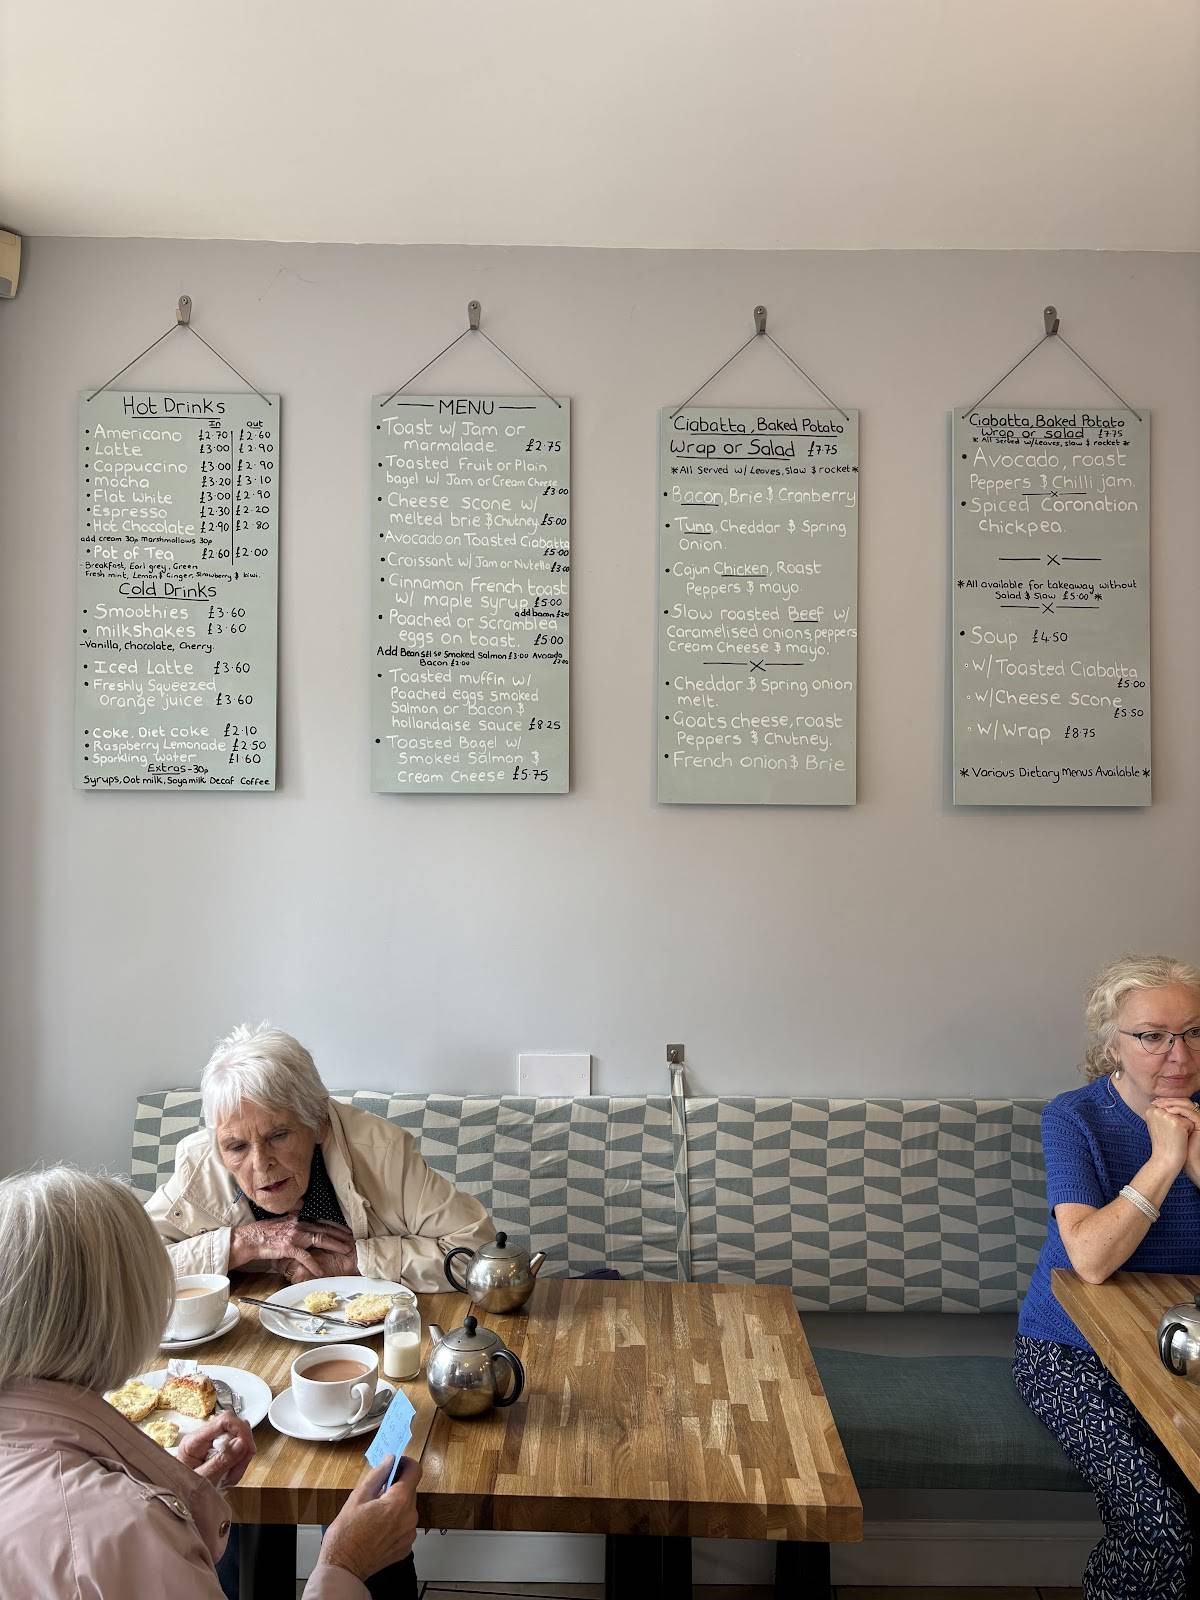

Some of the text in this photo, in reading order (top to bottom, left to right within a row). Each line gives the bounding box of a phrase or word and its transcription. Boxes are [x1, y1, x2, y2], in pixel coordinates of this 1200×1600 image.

[123, 396, 225, 415] Hot Drinks
[439, 400, 494, 415] MENU
[383, 417, 526, 436] Toast Jam or
[757, 417, 843, 433] Baked Potato
[1036, 415, 1125, 427] Baked Potato
[94, 424, 182, 442] Americano
[95, 442, 143, 456] Latte
[670, 439, 795, 458] Wrap or Salad
[385, 455, 547, 472] Toasted Fruit or Plain
[1073, 448, 1127, 467] roast
[94, 460, 187, 477] Cappuccino
[386, 471, 558, 489] bagel Jam or Cream Cheese
[970, 474, 1093, 495] Peppers Chilli
[94, 490, 124, 503] Flat
[388, 492, 449, 509] Cheese
[729, 488, 855, 507] Brie Cranberry
[93, 505, 167, 521] Espresso
[969, 496, 1138, 516] Spiced Coronation
[390, 511, 480, 527] melted brie
[93, 521, 195, 535] Hot Chocolate
[720, 520, 846, 537] Cheddar Spring
[385, 530, 569, 549] Avocado on Toasted Ciabatta
[94, 546, 174, 561] Pot of Tea
[388, 552, 550, 570] Croissant Jam or Nutella
[85, 562, 126, 570] Breakfast,
[673, 560, 822, 579] Cajun Roast
[119, 581, 216, 597] Cold Drinks
[389, 573, 568, 597] Cinnamon French toast
[687, 582, 741, 599] Peppers
[981, 580, 1136, 594] available for takeaway without
[995, 591, 1021, 600] Salad
[94, 604, 189, 619] Smoothies
[424, 594, 529, 615] maple syrup
[671, 604, 824, 621] Slow roasted Beef
[390, 609, 475, 628] Poached or
[399, 630, 462, 648] eggs on
[667, 624, 857, 643] Caramelised peppers
[970, 626, 1018, 651] Soup
[377, 646, 398, 657] Add
[444, 651, 474, 660] Smoked
[669, 641, 768, 653] Cream Cheese
[94, 659, 138, 674] Iced
[147, 659, 193, 675] Latte
[1071, 661, 1138, 678] Ciabatta
[389, 668, 504, 685] Toasted muffin
[94, 677, 216, 697] Freshly Squeezed
[674, 674, 852, 697] Cheddar Spring onion
[100, 695, 155, 714] Orange
[164, 695, 203, 710] juice
[391, 687, 484, 705] Poached eggs
[391, 702, 512, 715] Salmon or Bacon
[392, 715, 471, 731] hollandaise
[673, 711, 843, 729] Goats roast
[139, 727, 165, 737] Diet
[678, 731, 741, 750] Peppers
[94, 739, 226, 754] Raspberry Lemonade
[386, 735, 497, 754] Toasted Bagel
[93, 753, 147, 766] Sparkling
[399, 752, 523, 765] Smoked Salmon
[674, 751, 846, 771] French Brie
[84, 776, 269, 786] Syrups, Oat Decaf Coffee
[398, 771, 443, 784] Cream
[451, 771, 505, 783] Cheese
[972, 766, 1140, 783] Various Dietary Available
